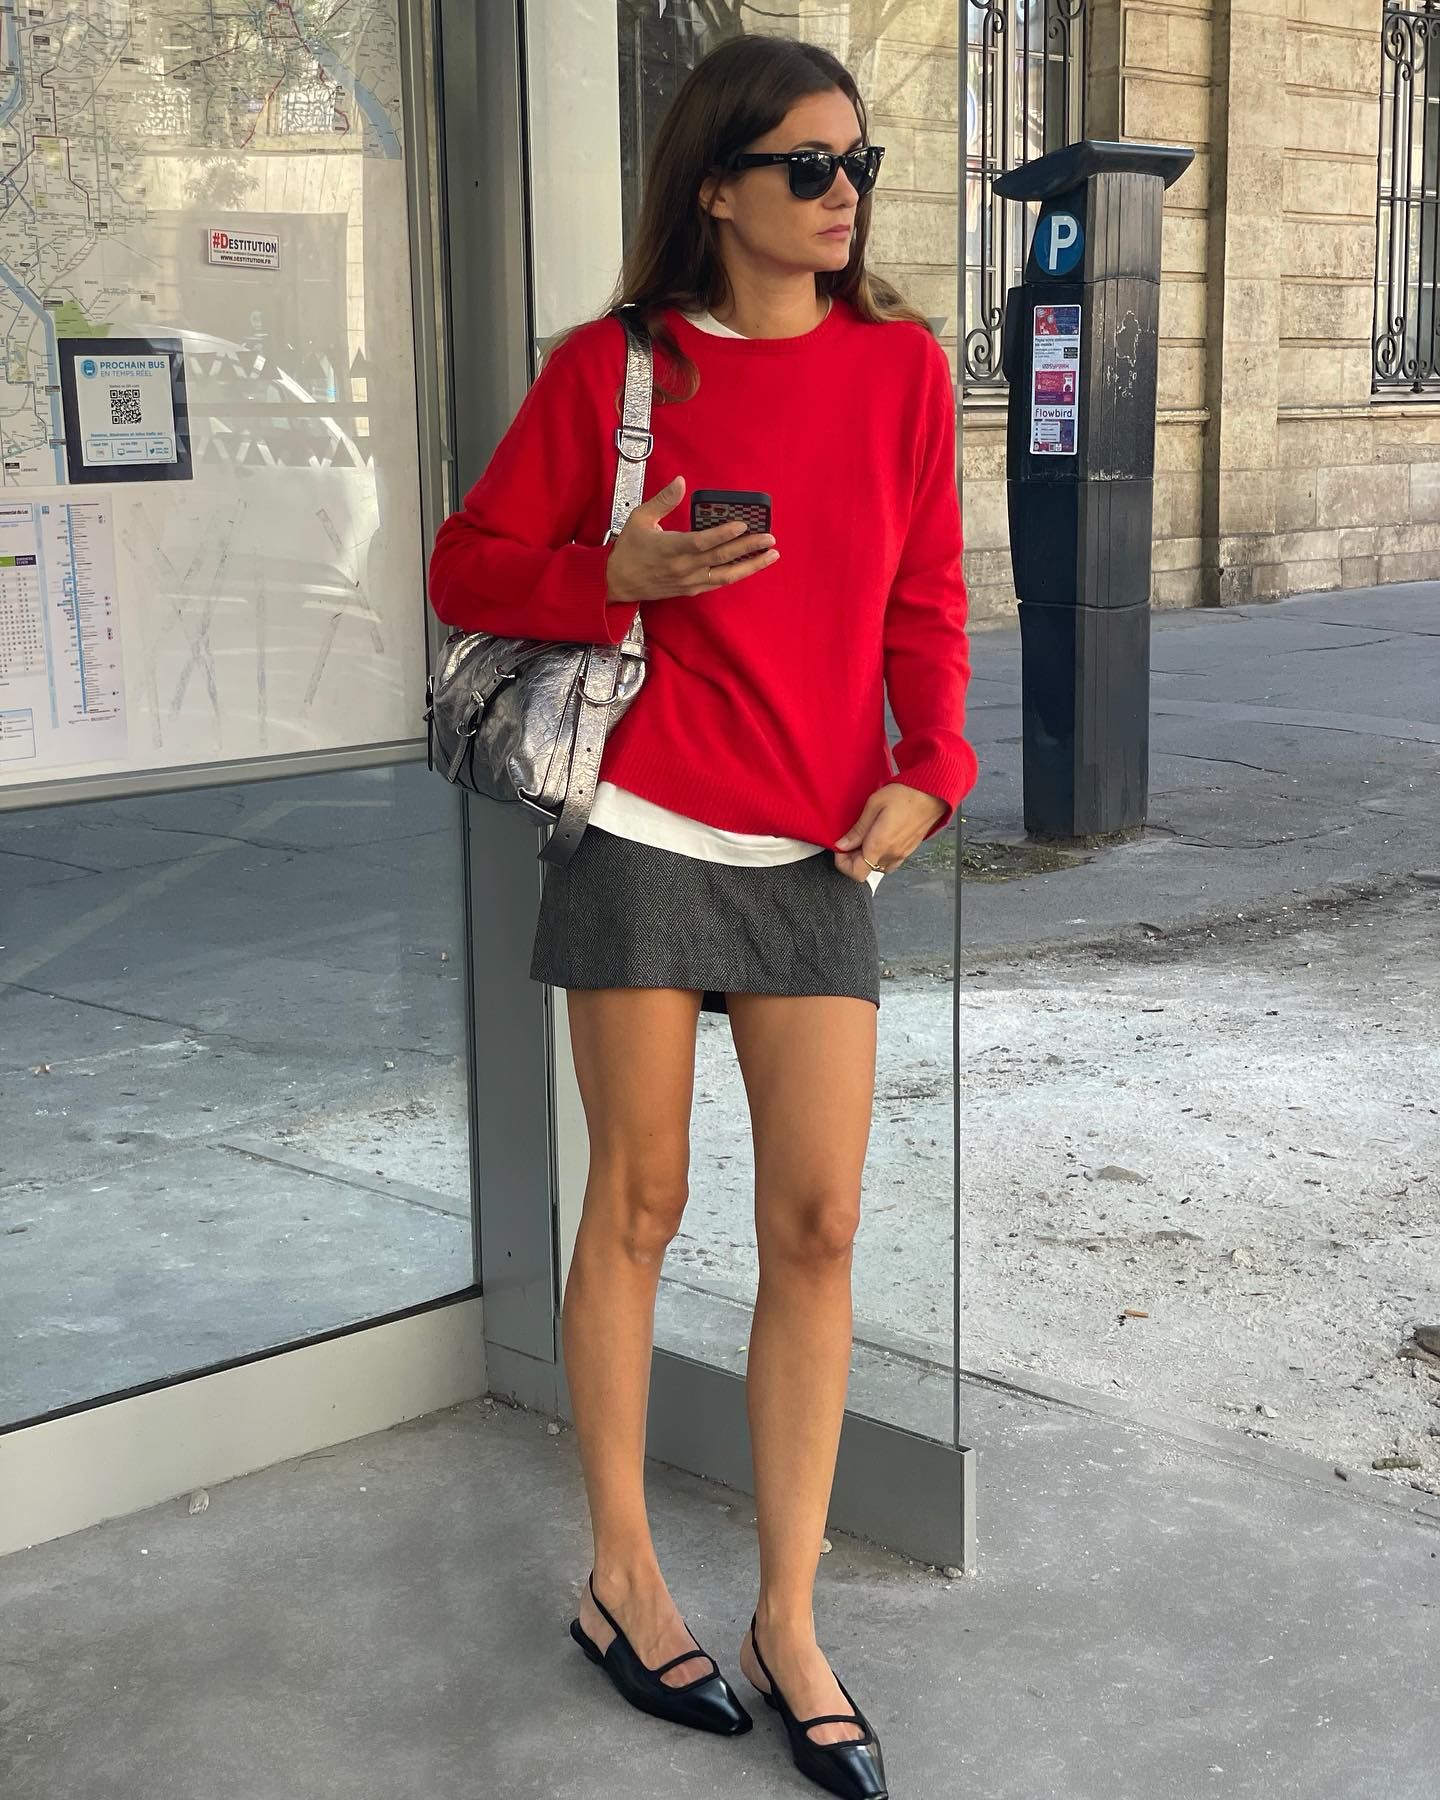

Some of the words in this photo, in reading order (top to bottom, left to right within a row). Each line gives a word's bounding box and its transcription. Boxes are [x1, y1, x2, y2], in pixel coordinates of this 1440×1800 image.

[1048, 215, 1078, 270] P
[100, 361, 146, 369] PROCHAIN
[148, 361, 165, 369] BUS
[135, 369, 153, 377] RÉEL
[1035, 408, 1073, 418] flowbird
